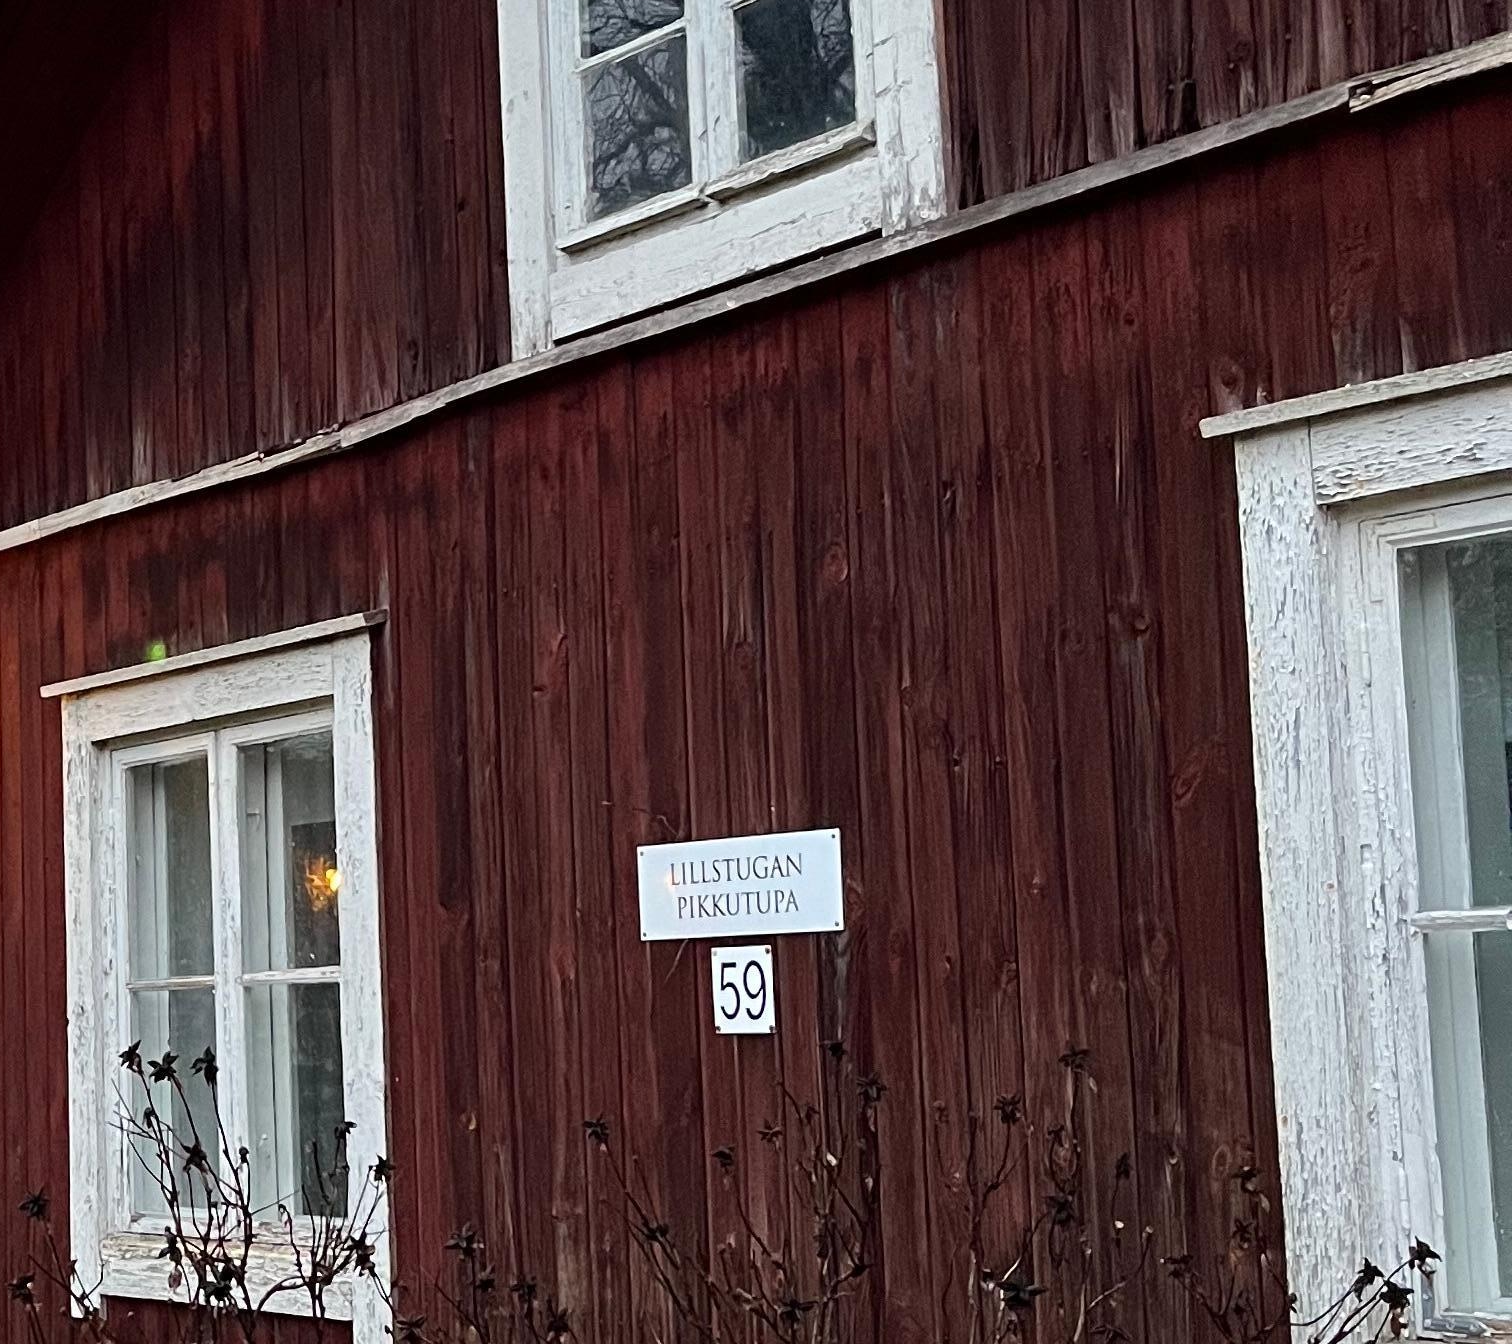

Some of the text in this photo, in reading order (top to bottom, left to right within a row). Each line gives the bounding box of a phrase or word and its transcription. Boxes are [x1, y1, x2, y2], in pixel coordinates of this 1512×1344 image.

[670, 853, 803, 886] LILLSTUGAN
[677, 889, 799, 919] PIKKUTUPA
[720, 960, 767, 1020] 59
